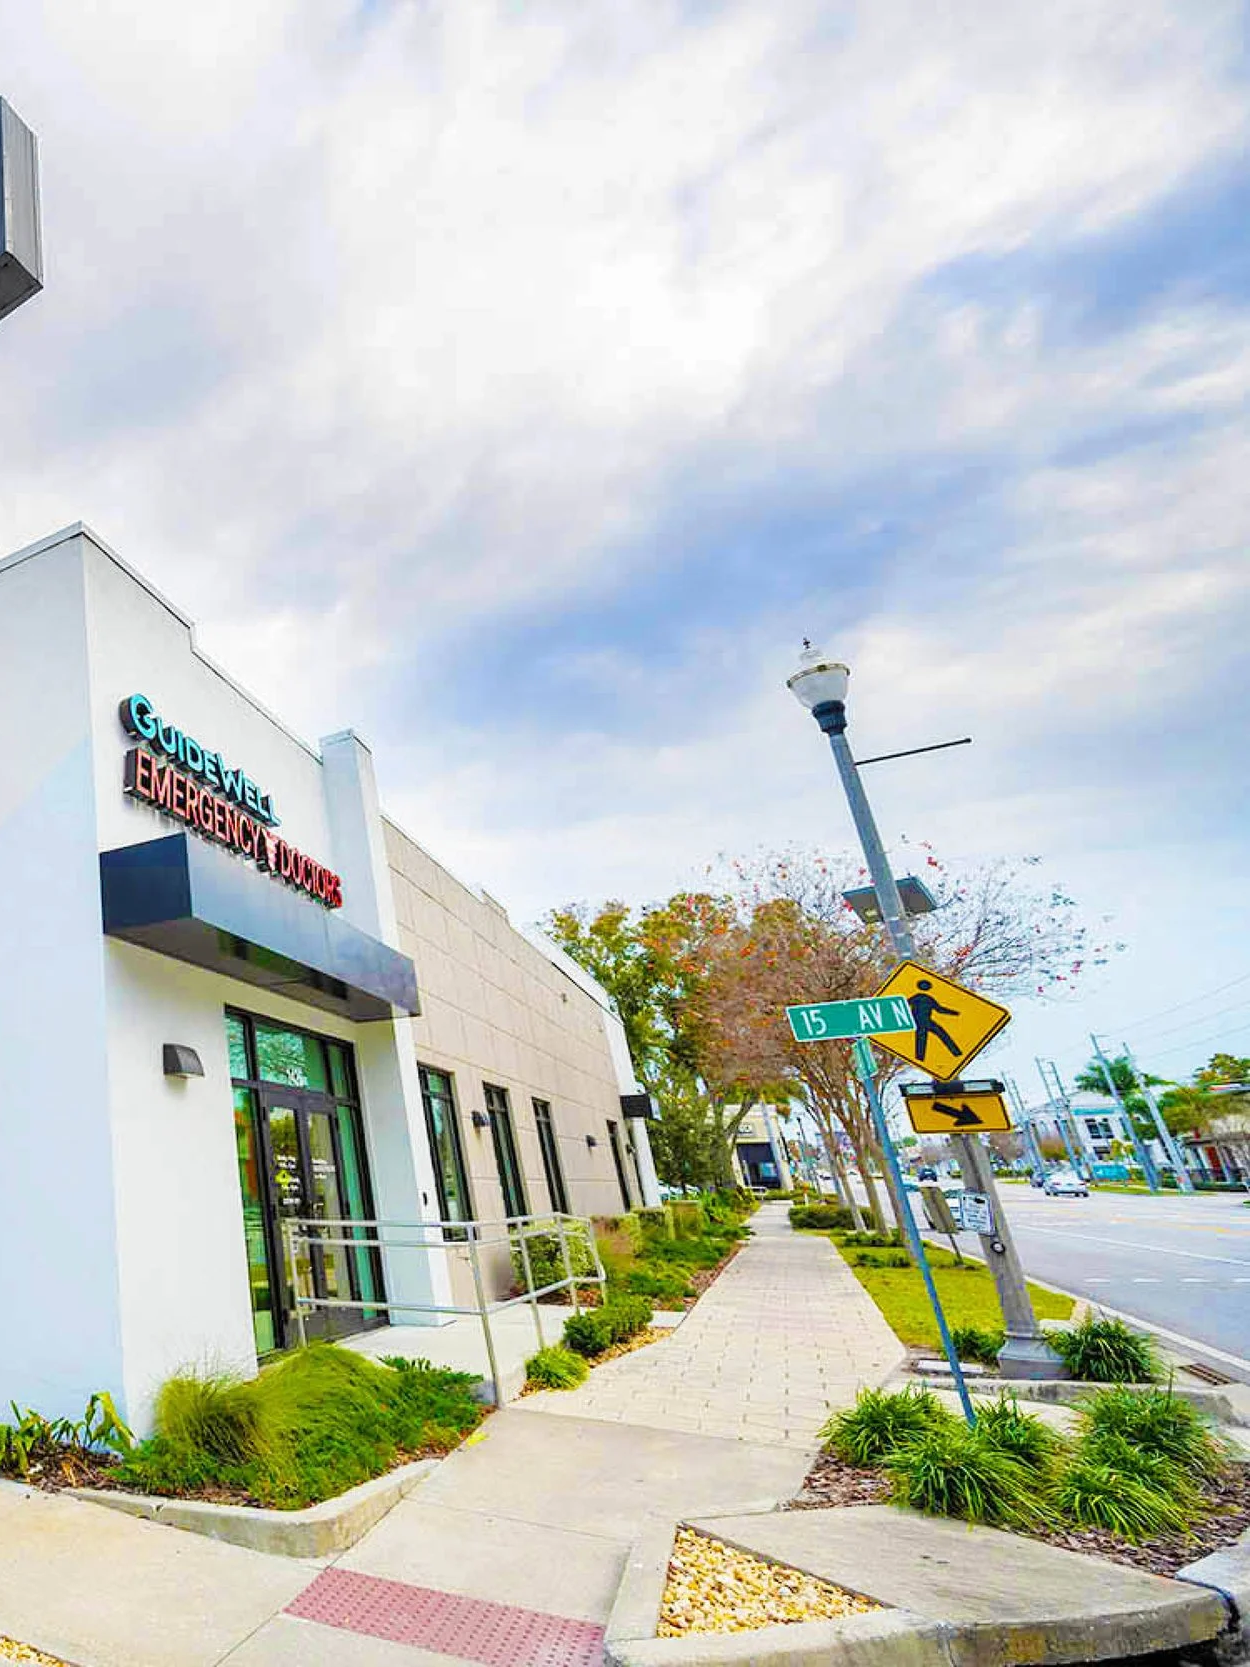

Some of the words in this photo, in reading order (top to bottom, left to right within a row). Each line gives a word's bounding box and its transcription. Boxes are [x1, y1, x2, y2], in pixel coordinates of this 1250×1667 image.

[127, 747, 262, 861] EMERGENCY
[280, 839, 343, 908] DOCTORS
[800, 1009, 828, 1036] 15
[858, 1001, 884, 1031] AV
[890, 999, 911, 1028] N
